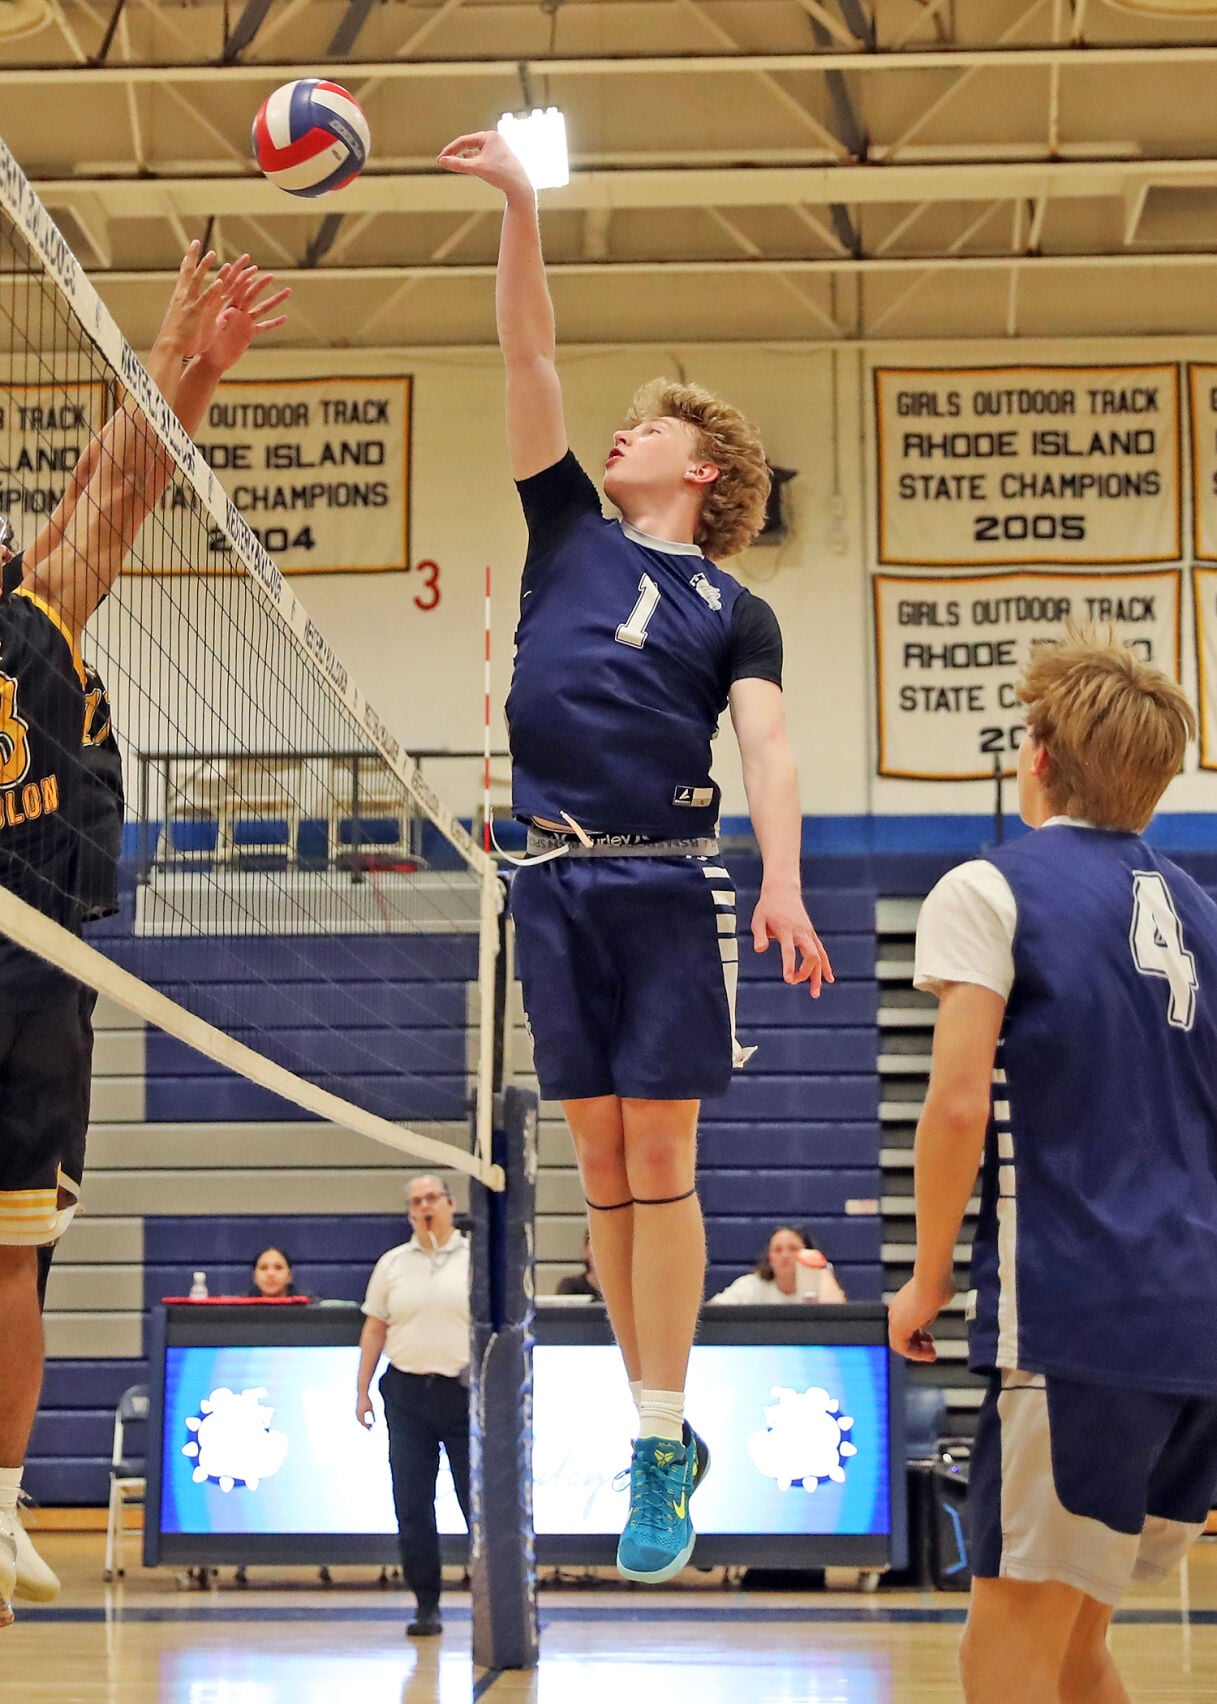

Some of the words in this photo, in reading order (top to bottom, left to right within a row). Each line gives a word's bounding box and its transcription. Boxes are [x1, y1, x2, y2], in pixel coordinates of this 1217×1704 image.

[209, 403, 308, 428] OUTDOOR
[322, 399, 389, 426] TRACK
[897, 391, 960, 416] GIRLS
[973, 389, 1075, 416] OUTDOOR
[1088, 387, 1159, 413] TRACK
[18, 405, 85, 430] TRACK
[266, 441, 385, 469] ISLAND
[903, 431, 1018, 459] RHODE
[1032, 430, 1155, 457] ISLAND
[232, 482, 389, 511] CHAMPIONS
[899, 474, 986, 501] STATE
[1000, 470, 1161, 499] CHAMPIONS
[974, 515, 1085, 542] 2005
[413, 560, 441, 611] 3
[615, 573, 661, 649] 1
[898, 600, 960, 627] GIRLS
[972, 597, 1071, 625] OUTDOOR
[1087, 595, 1156, 622] TRACK
[904, 640, 1017, 669] RHODE
[899, 684, 985, 713] STATE
[979, 726, 1028, 754] 20
[588, 833, 631, 847] urley
[1129, 869, 1199, 1031] 4
